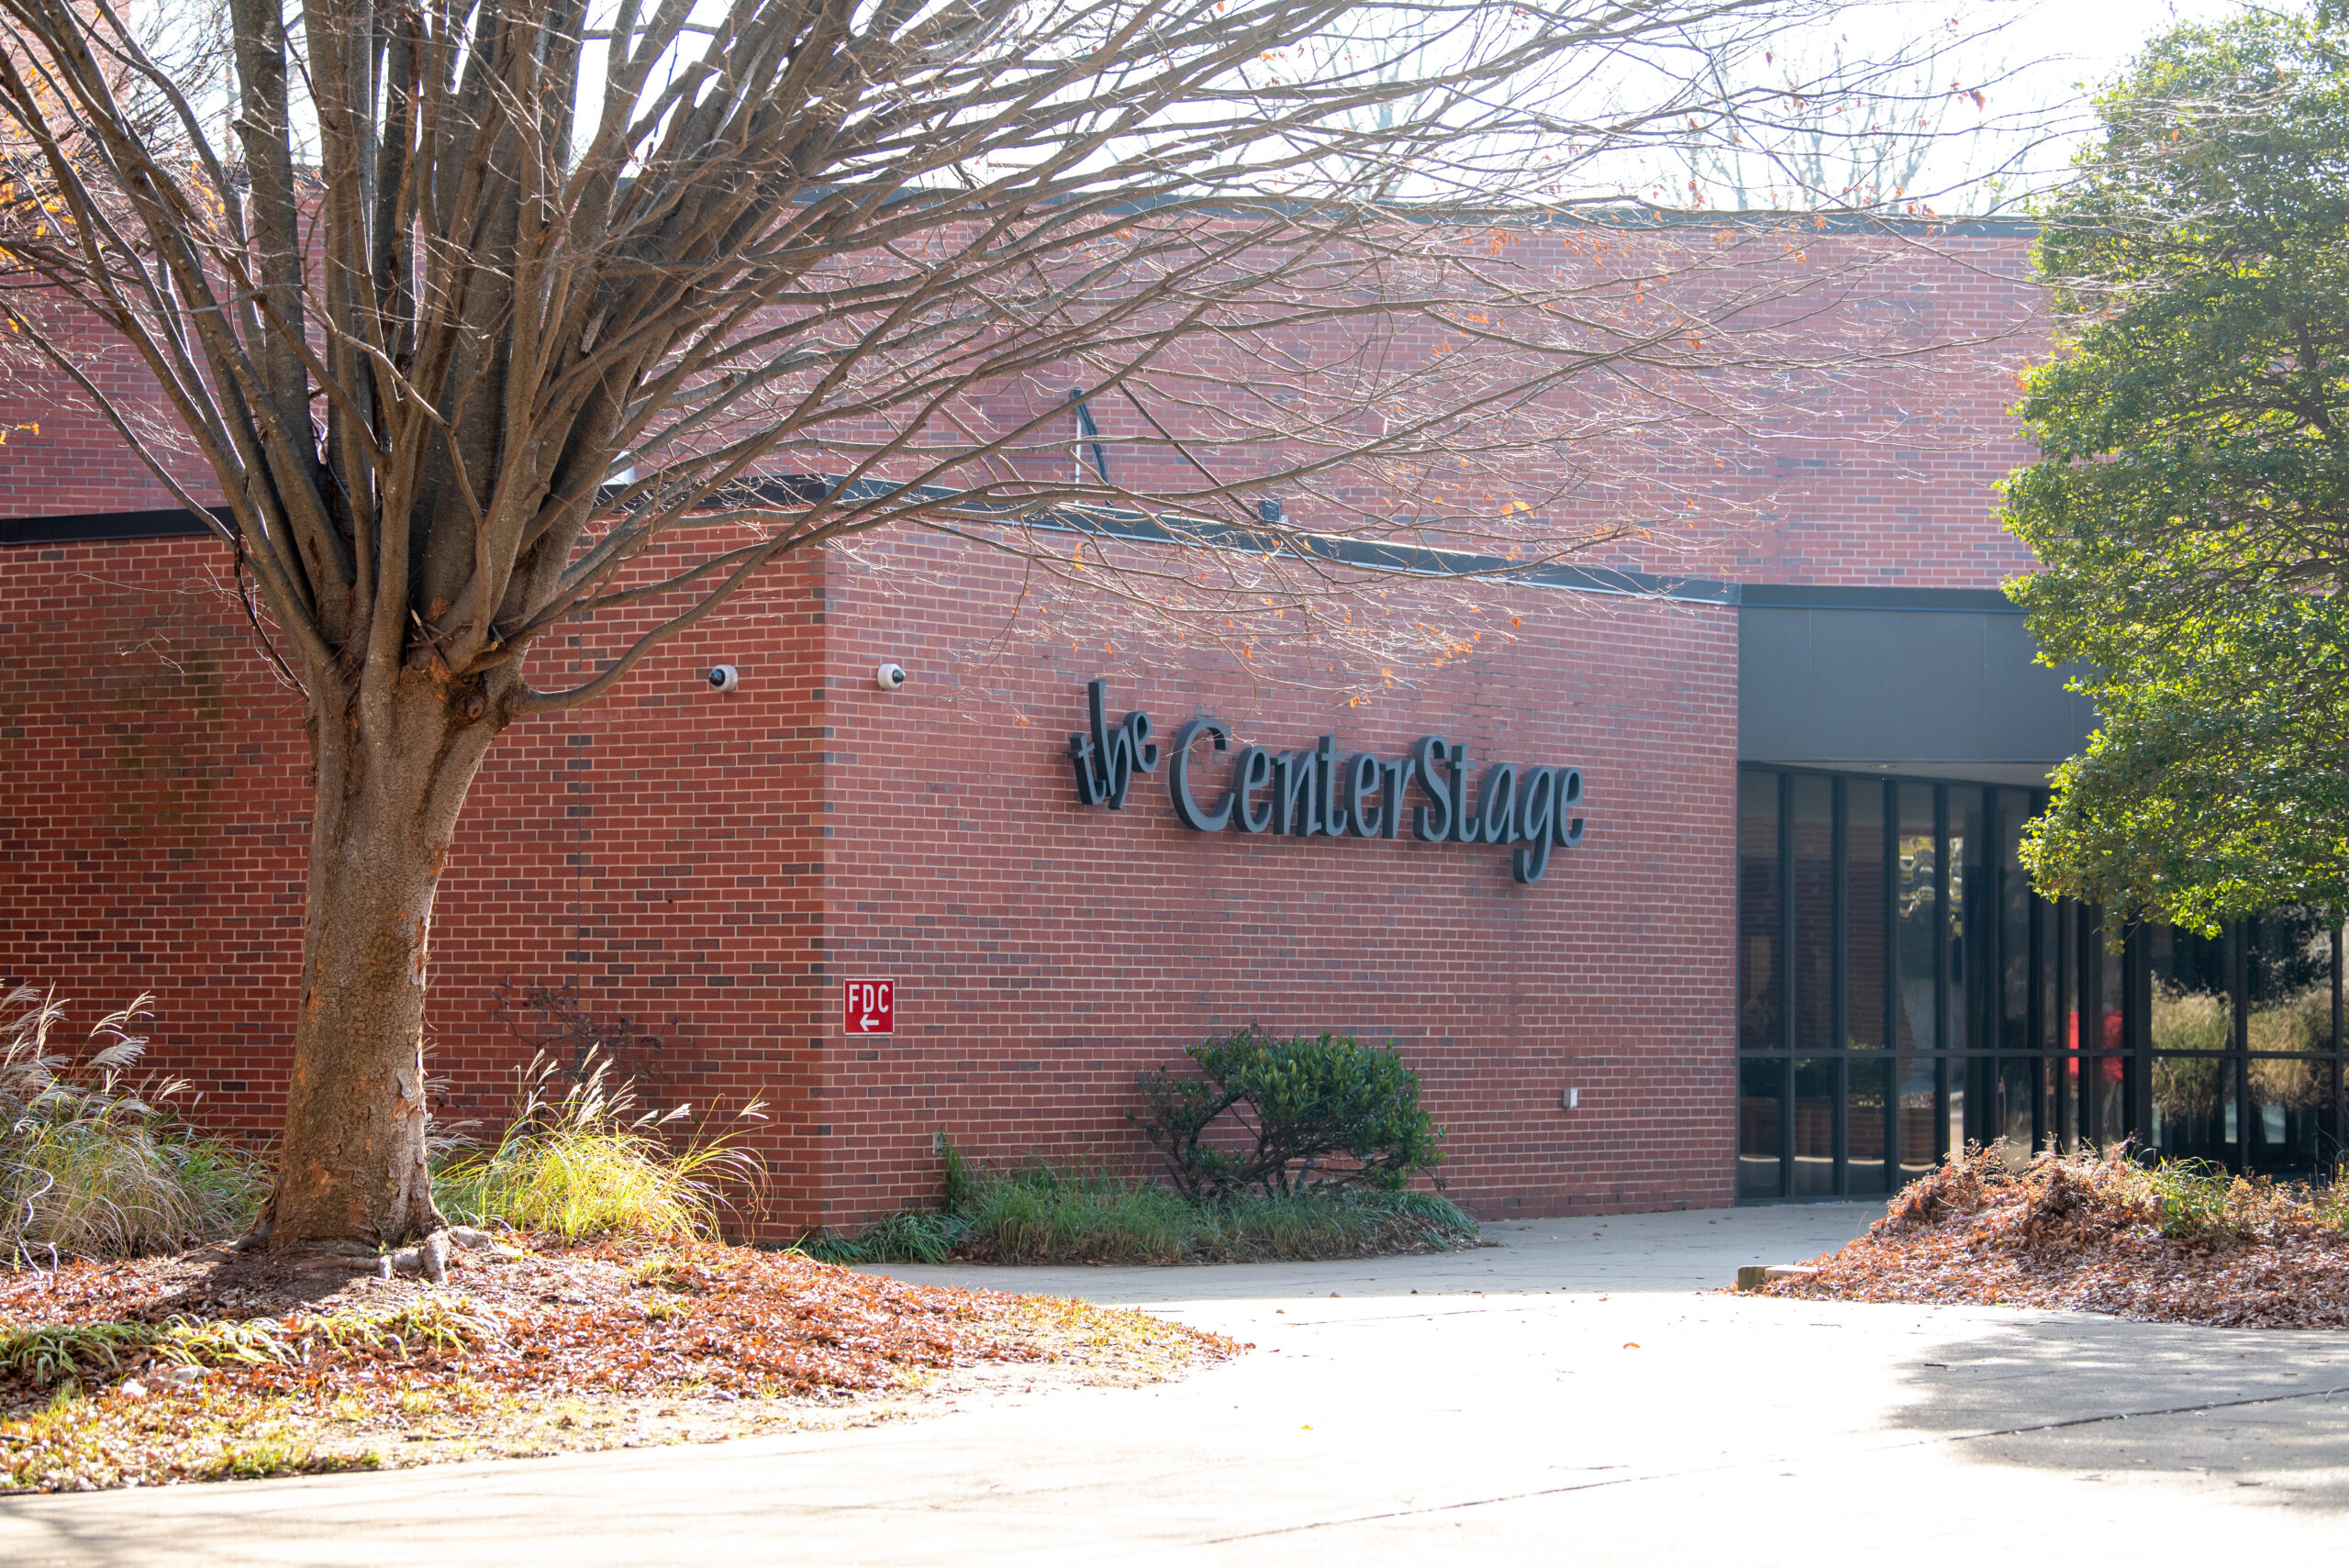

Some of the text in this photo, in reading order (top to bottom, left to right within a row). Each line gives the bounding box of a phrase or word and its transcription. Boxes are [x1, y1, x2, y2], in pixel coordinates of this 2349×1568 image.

[1070, 679, 1585, 884] the CenterStage
[849, 984, 889, 1014] FDC
